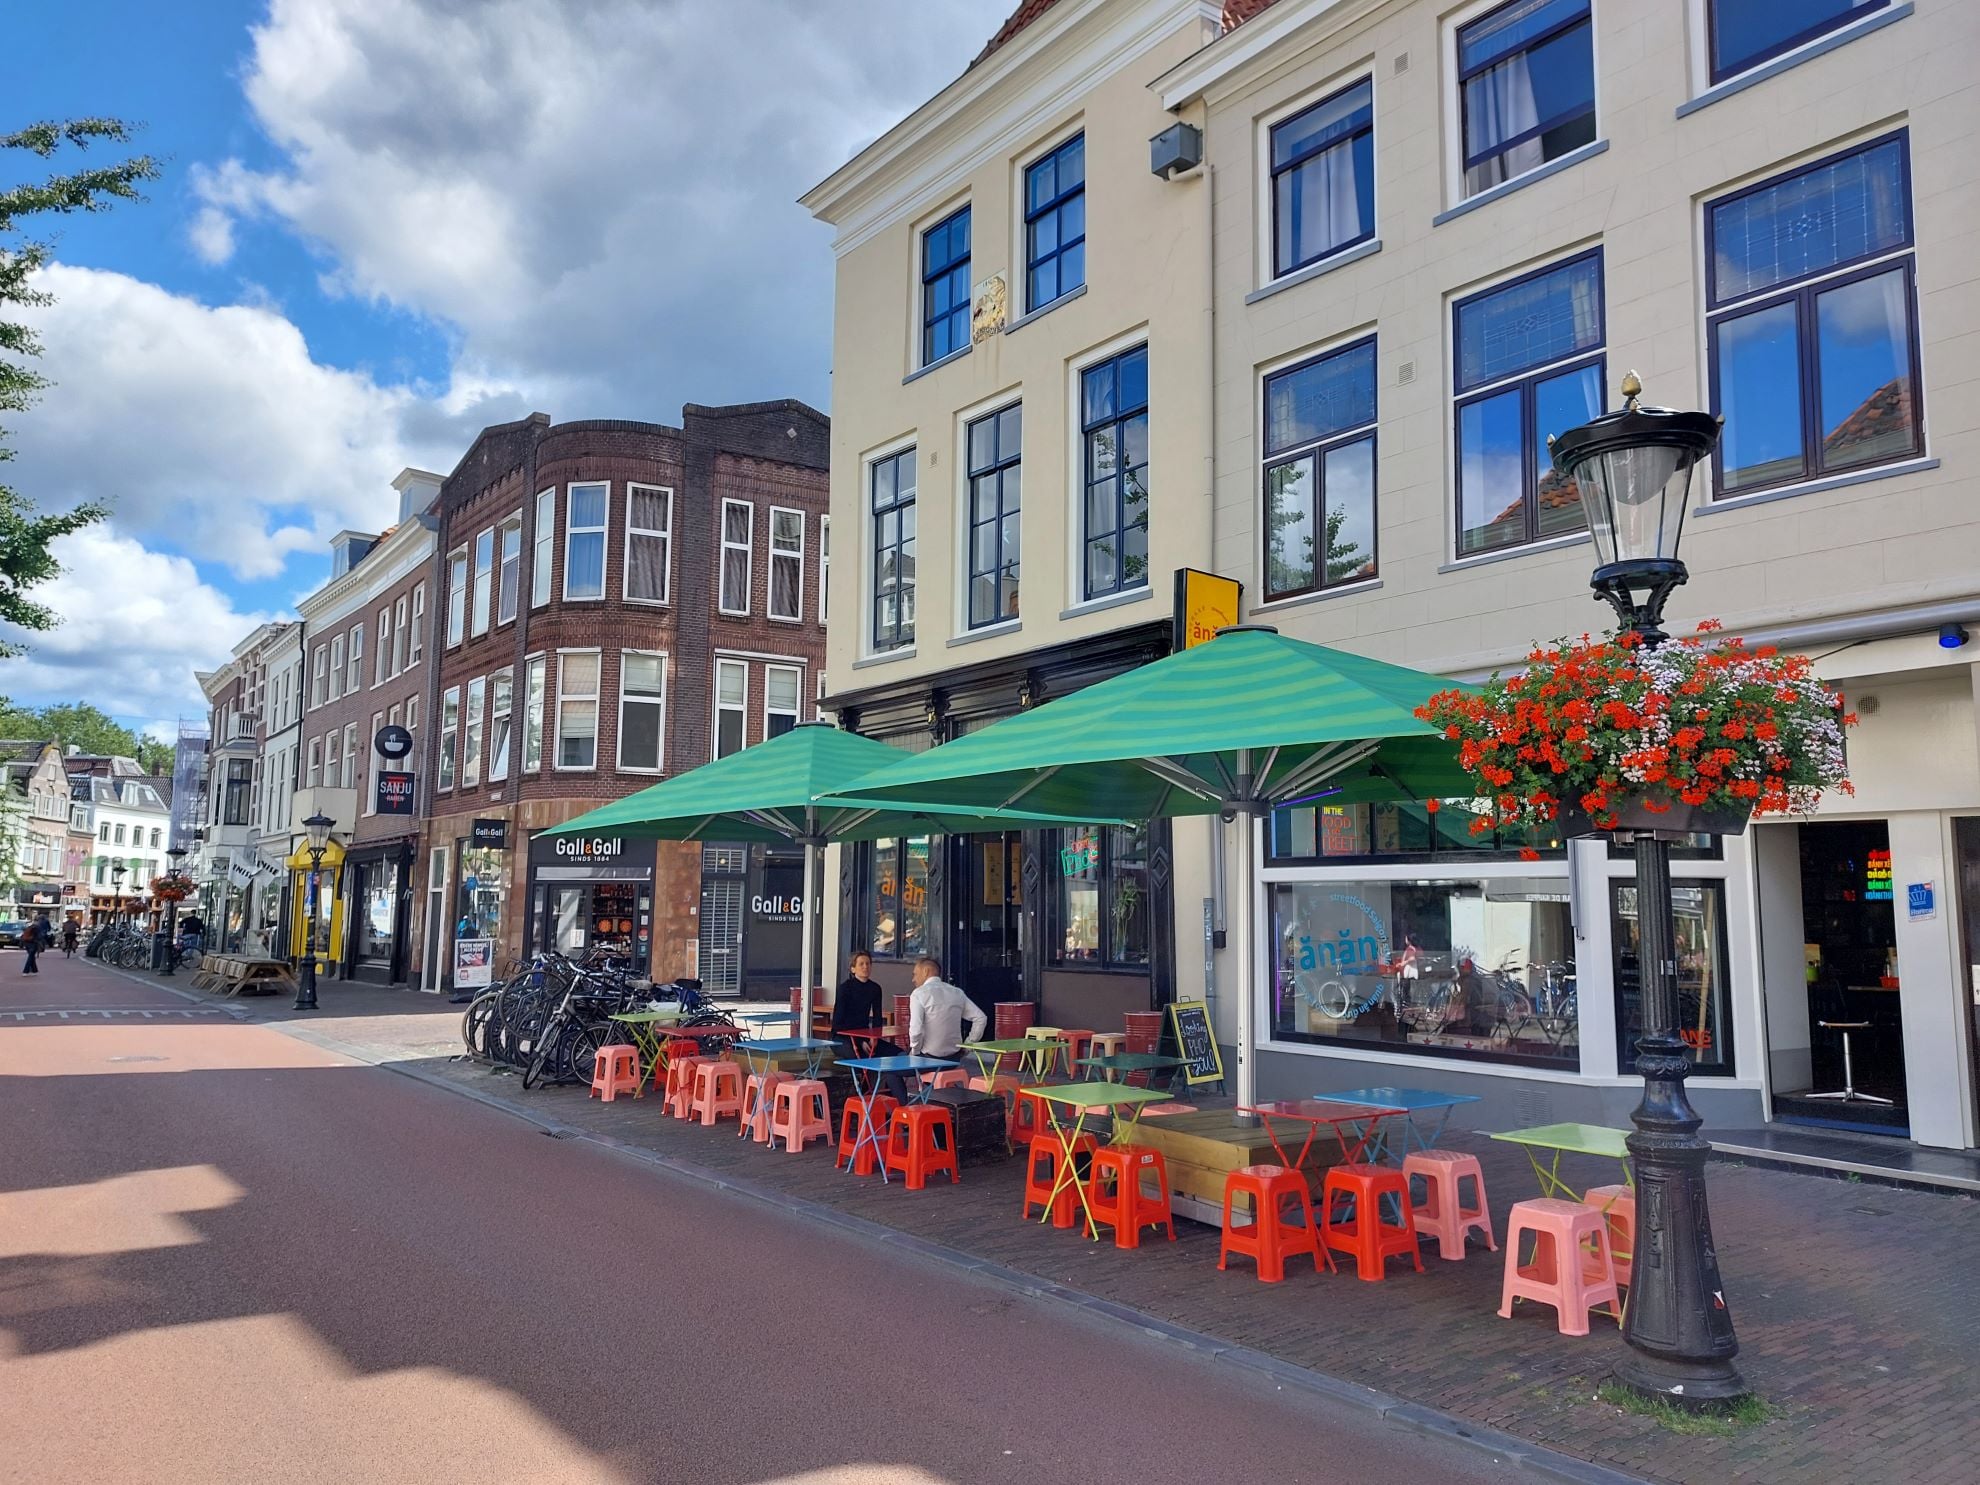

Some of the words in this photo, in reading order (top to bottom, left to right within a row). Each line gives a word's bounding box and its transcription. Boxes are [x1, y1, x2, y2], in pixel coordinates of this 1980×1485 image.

[380, 781, 412, 795] SANJU
[555, 837, 621, 856] Gall&Gall
[1300, 928, 1378, 971] ănăn
